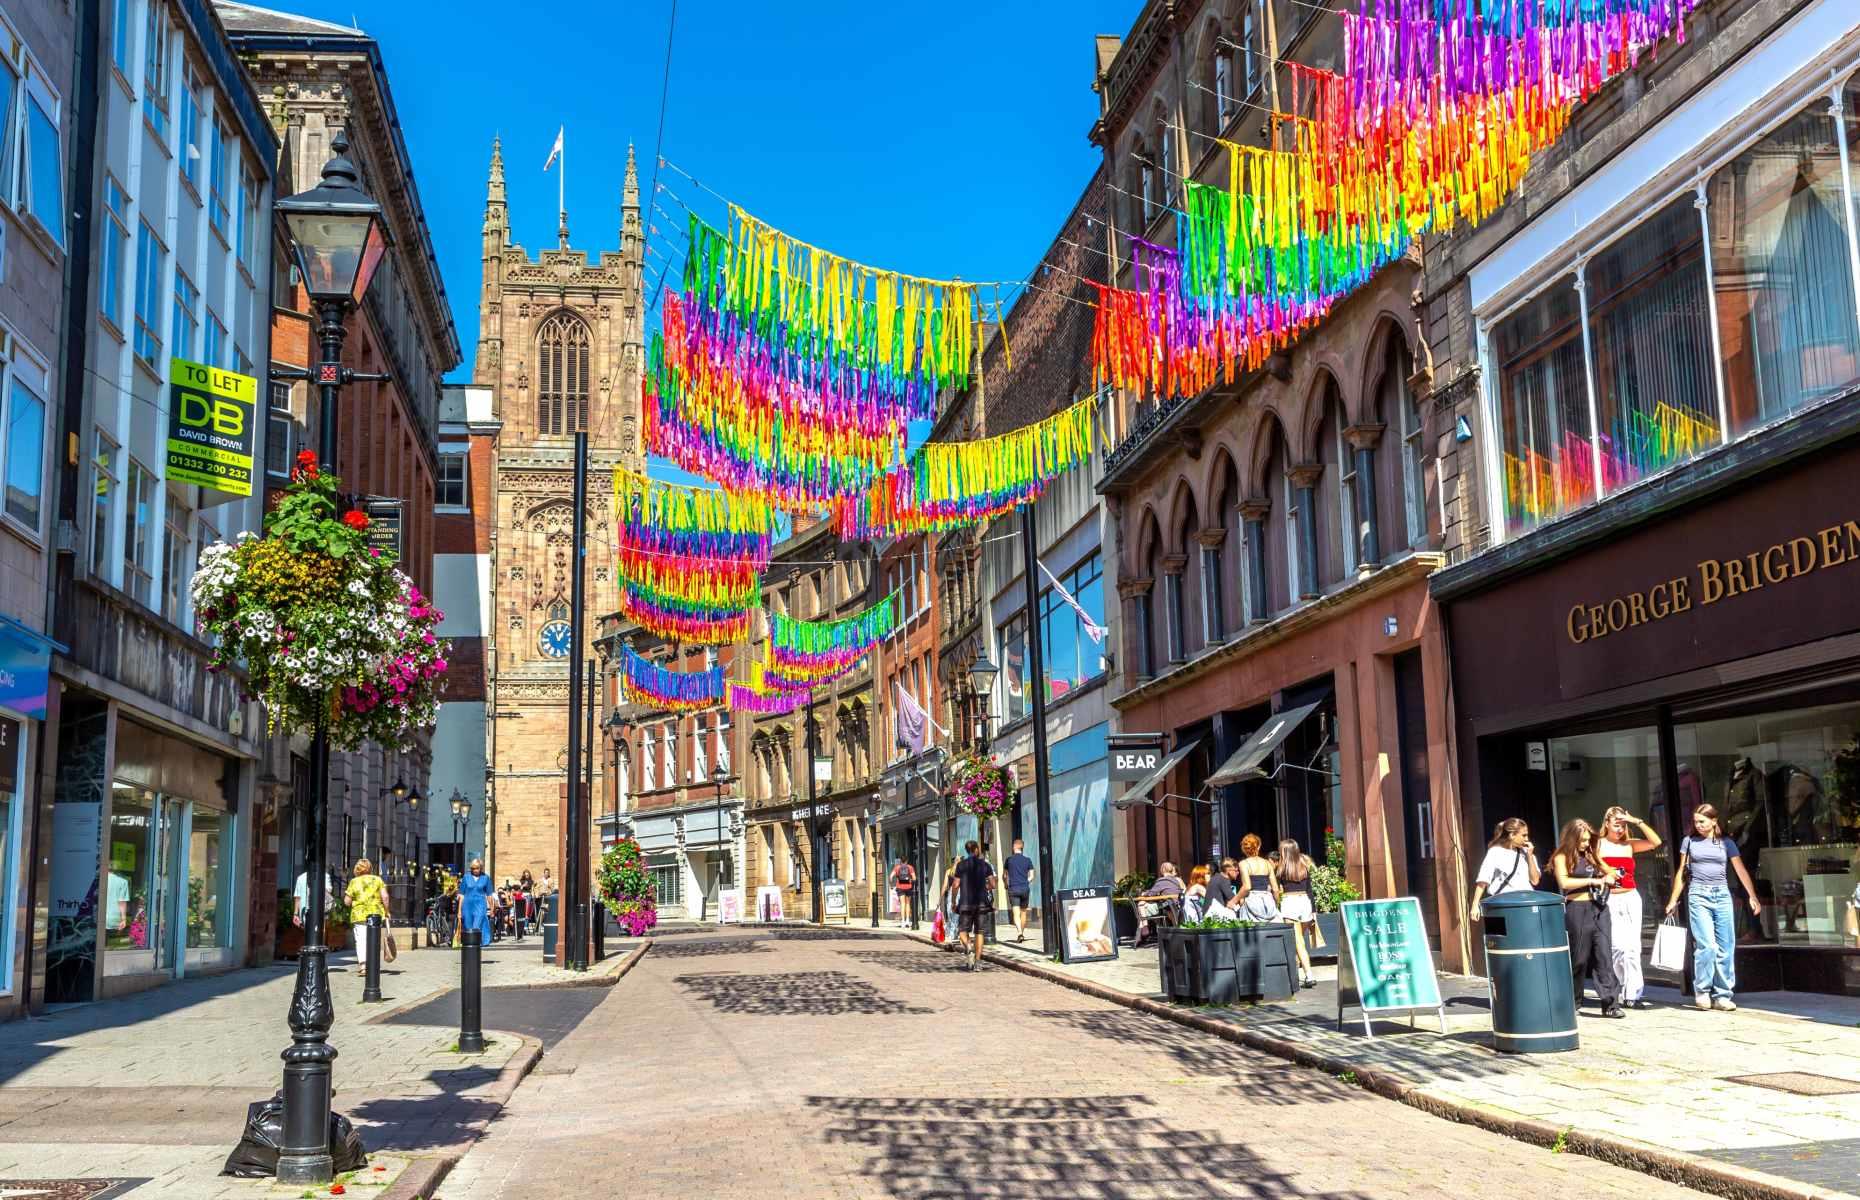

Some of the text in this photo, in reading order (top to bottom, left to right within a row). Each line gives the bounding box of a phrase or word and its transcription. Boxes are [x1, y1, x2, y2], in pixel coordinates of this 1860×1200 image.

[185, 365, 242, 392] TO LET
[179, 428, 242, 450] DAVID BROWN
[178, 444, 241, 463] COMMERCIAL
[170, 455, 248, 480] 01332 200 232
[1567, 576, 1691, 644] GEORGE
[1116, 754, 1156, 769] BEAR
[1072, 889, 1096, 898] BEAR
[1363, 922, 1409, 936] SALE
